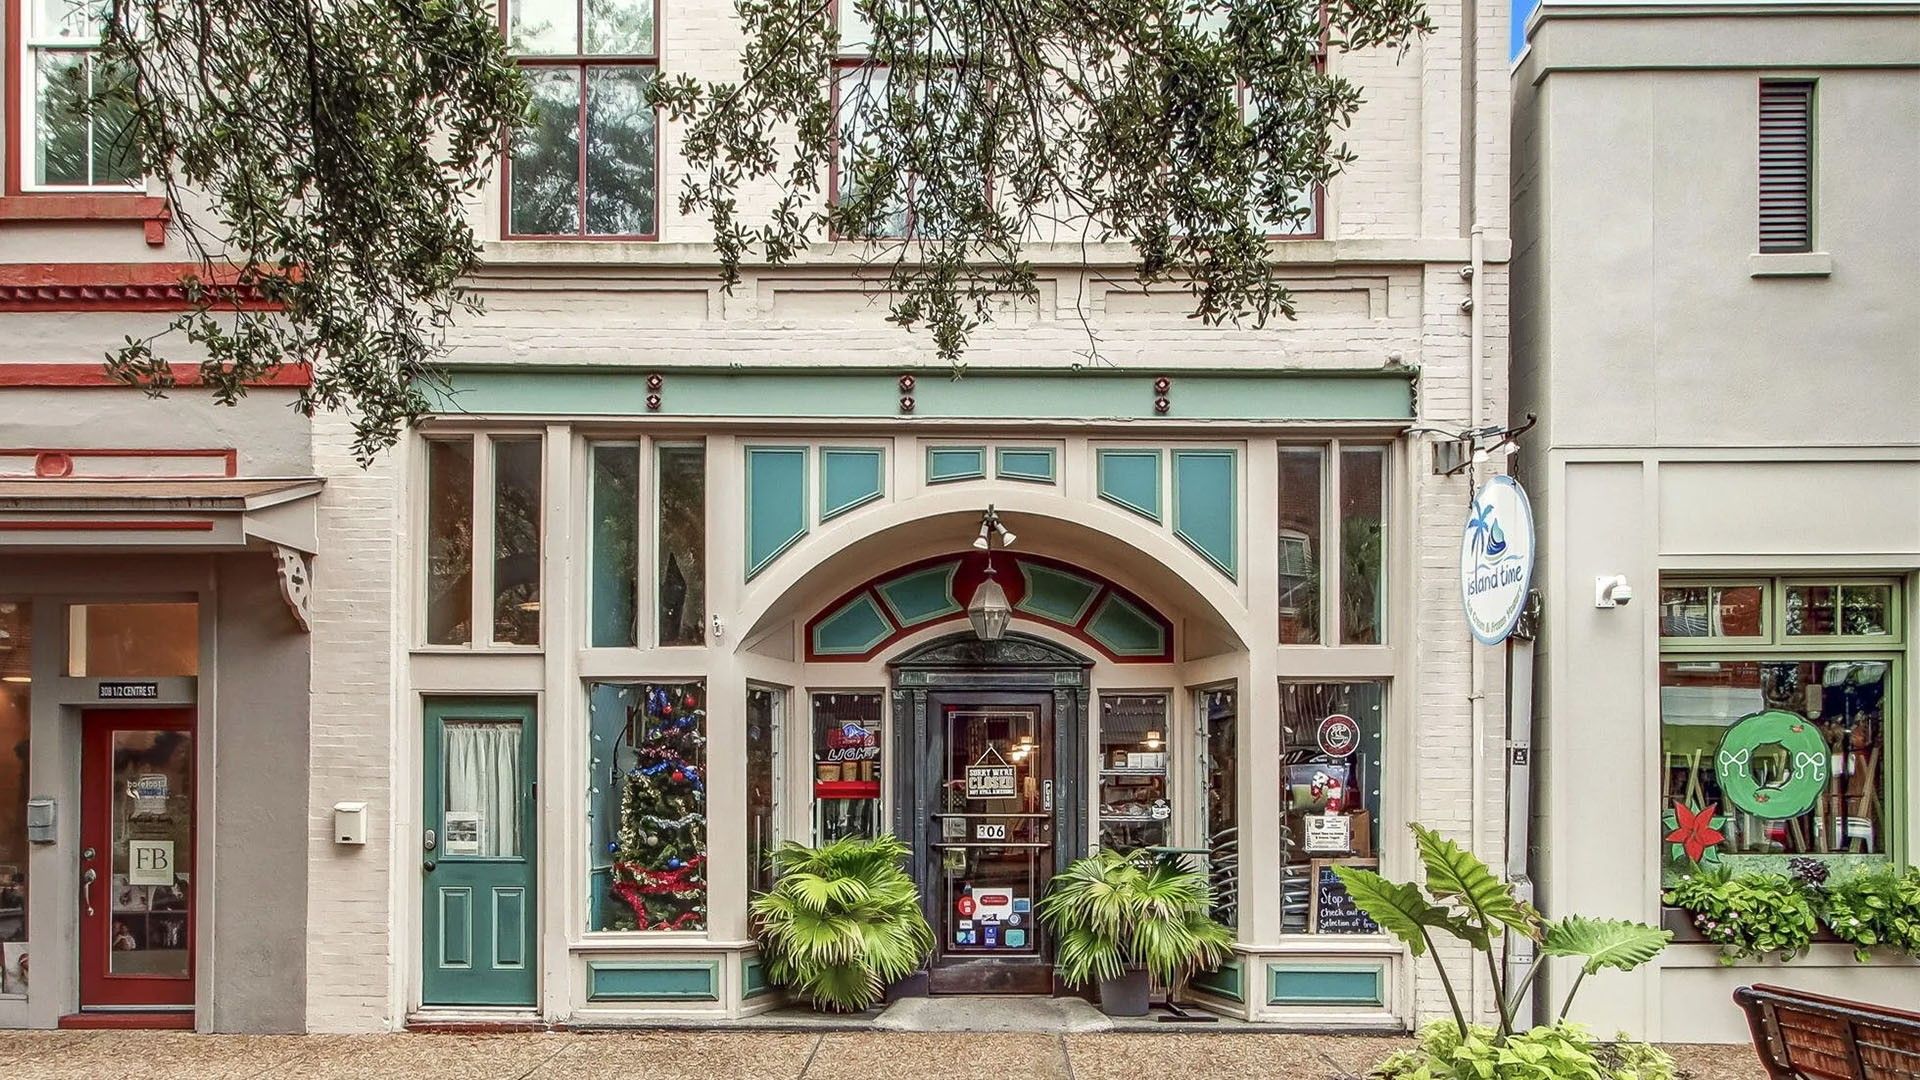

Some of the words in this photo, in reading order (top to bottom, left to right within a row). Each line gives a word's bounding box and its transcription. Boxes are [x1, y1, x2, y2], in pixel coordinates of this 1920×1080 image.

[1467, 567, 1498, 596] island
[1500, 564, 1523, 587] time
[123, 686, 147, 697] CENTRE
[147, 686, 157, 697] ST.
[828, 747, 875, 761] LIGHT
[969, 768, 990, 777] SORRY
[969, 776, 1014, 789] CLOSED
[979, 825, 1004, 838] 306
[136, 847, 168, 870] FB
[1320, 886, 1344, 907] Stop
[1346, 908, 1358, 917] out
[1320, 918, 1350, 929] Selection
[1351, 917, 1361, 927] of
